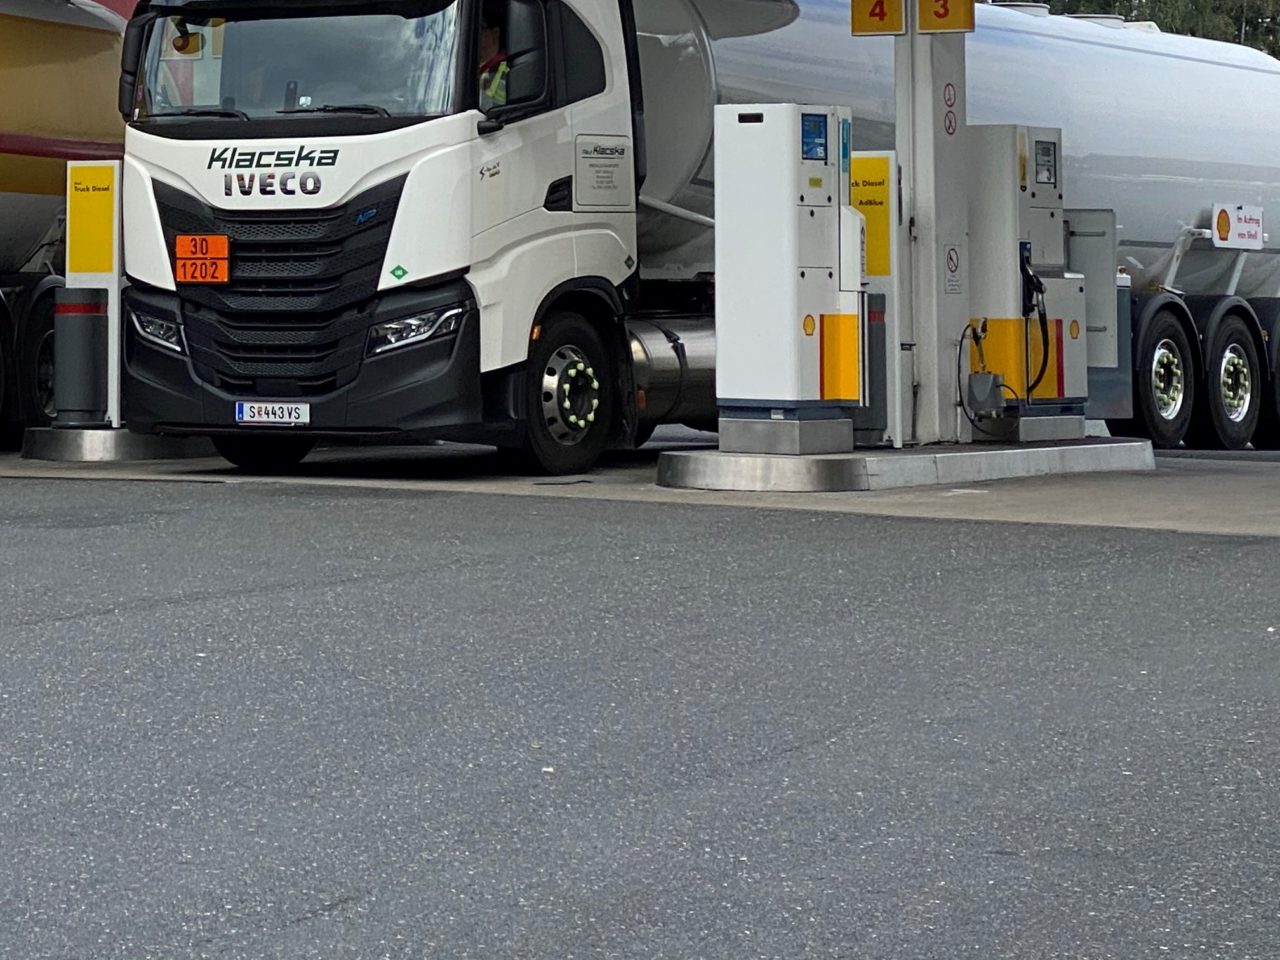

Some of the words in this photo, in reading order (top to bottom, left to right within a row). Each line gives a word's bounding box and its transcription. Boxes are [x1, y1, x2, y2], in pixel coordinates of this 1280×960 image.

[869, 0, 887, 22] 4
[207, 145, 340, 170] Klacska
[223, 171, 322, 197] IVECO
[862, 178, 885, 188] Diesel
[859, 199, 884, 207] AdBlue
[190, 237, 208, 256] 30
[181, 261, 219, 280] 1202
